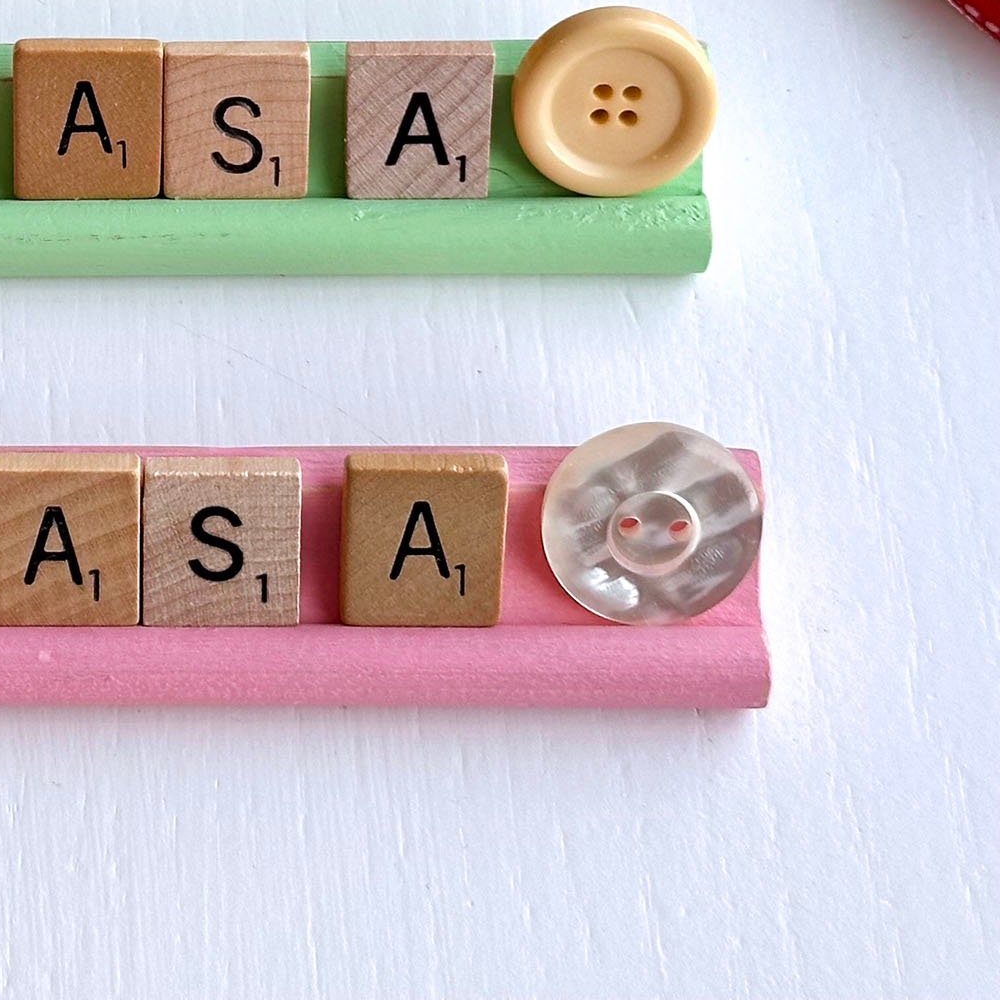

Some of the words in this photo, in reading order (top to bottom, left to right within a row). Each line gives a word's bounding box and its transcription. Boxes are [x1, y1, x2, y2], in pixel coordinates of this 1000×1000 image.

[383, 90, 451, 168] A
[115, 139, 128, 170] 1
[268, 155, 282, 188] 1
[454, 153, 468, 184] 1
[388, 499, 452, 582] A
[87, 567, 102, 603] 1
[254, 572, 269, 605] 1
[452, 562, 467, 598] 1
